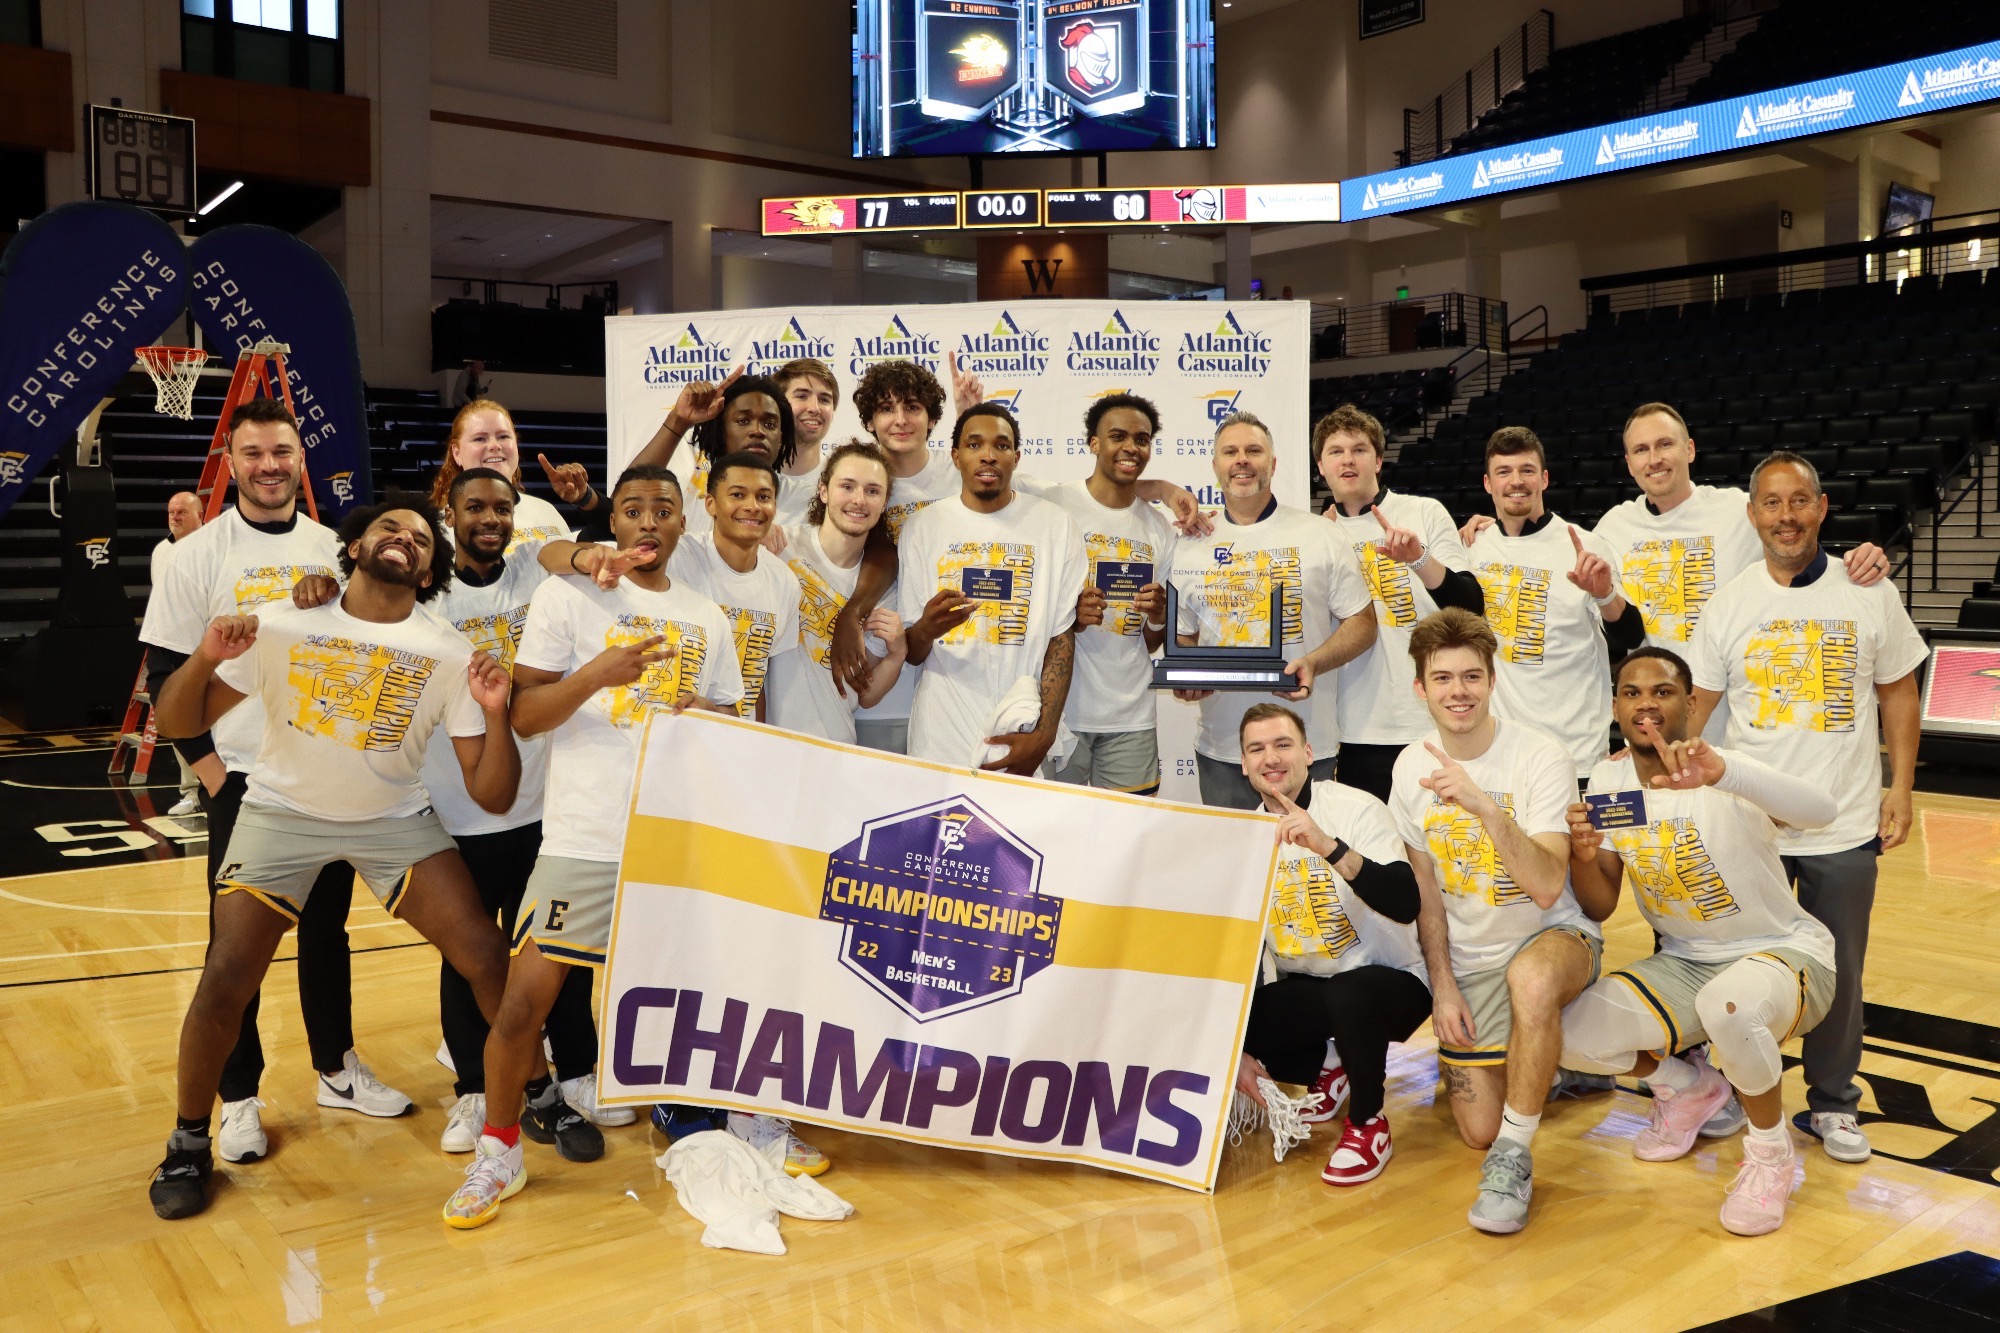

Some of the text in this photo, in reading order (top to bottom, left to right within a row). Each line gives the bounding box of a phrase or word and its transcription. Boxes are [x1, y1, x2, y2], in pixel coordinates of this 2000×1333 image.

[964, 4, 1000, 15] EMMANUEL
[1060, 0, 1098, 13] BELMONT
[1922, 58, 1978, 90] Atlantic
[1756, 88, 1855, 122] Atlantic Casualty
[118, 112, 168, 124] DAKTRONICS
[1763, 112, 1845, 133] INSURANCE COMPANY
[1613, 119, 1698, 149] Atlantic Casualty
[1488, 147, 1564, 174] Atlantic Casualty
[1376, 172, 1444, 197] Atlantic Casualty
[863, 197, 956, 227] 77 TOL FOULS
[977, 195, 1026, 217] 00.0
[1048, 193, 1145, 221] FOULS TOL 60
[1021, 259, 1063, 292] W
[7, 250, 160, 414] CONFERENCE
[957, 330, 1049, 353] Atlantic
[1067, 330, 1160, 351] Atlantic
[1178, 331, 1271, 352] Atlantic
[27, 265, 177, 427] CAROLINAS
[645, 341, 730, 365] Atlantic
[747, 336, 834, 361] Atlantic
[850, 333, 939, 356] Atlantic
[644, 364, 730, 384] Casualty
[957, 353, 1049, 376] Casualty
[1067, 352, 1160, 376] Casualty
[1178, 353, 1271, 378] Casualty
[948, 542, 1036, 555] 2022-23 CONFERENCE
[1632, 536, 1715, 553] 2022-23 CONFERENCE
[244, 565, 294, 580] 2022-23
[1173, 569, 1227, 577] CONFERENCE
[1197, 594, 1250, 602] CONFERENCE
[617, 614, 708, 639] 2022-23 CONFERENCE
[1512, 577, 1550, 666] CHAMPION
[1758, 619, 1858, 633] 2022-23 CONFERENCE
[304, 634, 442, 670] 2022-23 CONFERENCE
[1821, 631, 1859, 733] CHAMPION
[364, 661, 433, 752] CHAMPION
[904, 861, 989, 883] CAROLINAS
[905, 852, 991, 875] CONFERENCE
[1673, 828, 1742, 922] CHAMPION
[545, 899, 569, 931] E
[831, 876, 1053, 941] CHAMPIONSHIPS
[857, 941, 879, 958] 22
[990, 966, 1012, 983] 23
[612, 986, 1210, 1167] CHAMPIONS
